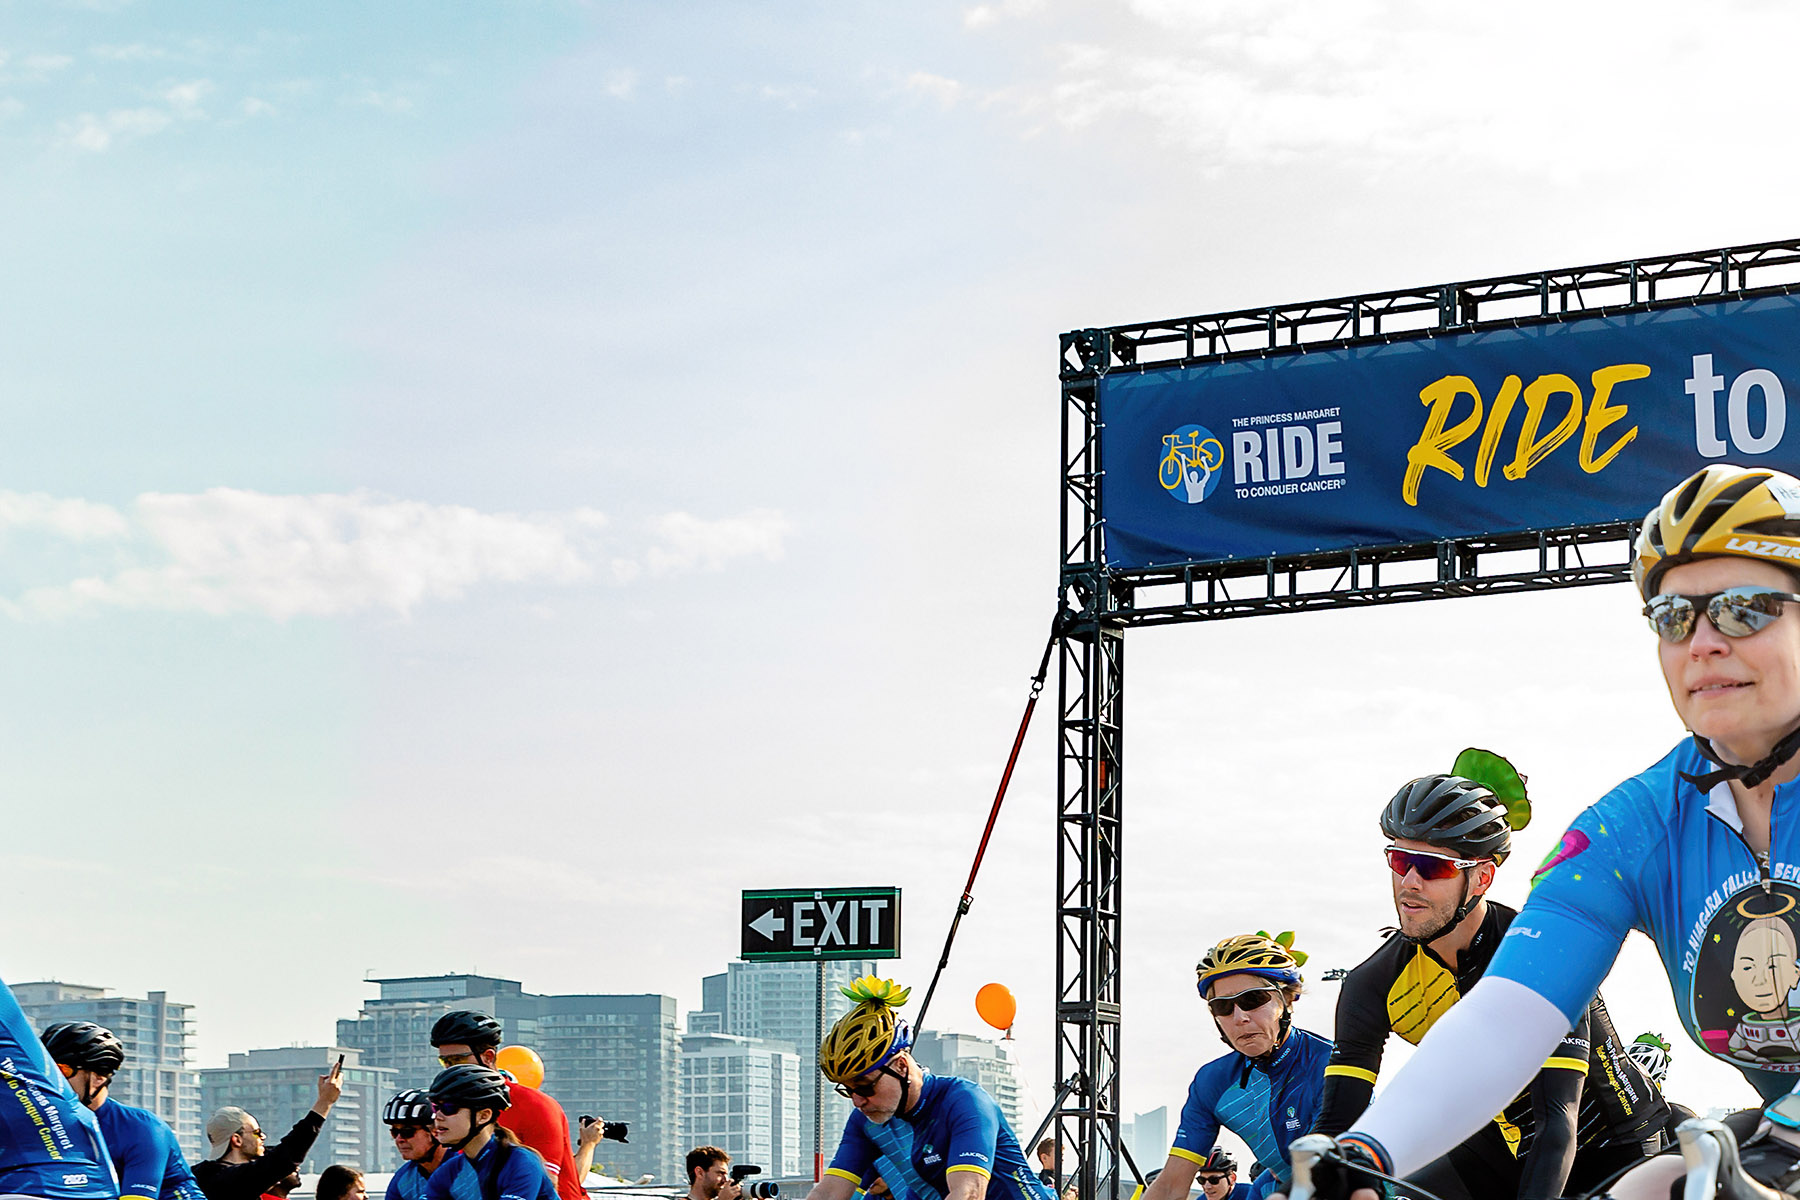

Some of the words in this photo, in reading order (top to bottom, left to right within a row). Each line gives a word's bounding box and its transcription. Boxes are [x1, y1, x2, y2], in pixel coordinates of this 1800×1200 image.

[1232, 418, 1249, 428] THE
[1250, 413, 1293, 425] PRINCESS
[1294, 407, 1341, 422] MARGARET
[1402, 363, 1652, 507] RIDE
[1684, 354, 1787, 458] to
[1232, 421, 1346, 485] RIDE
[1235, 488, 1249, 499] TO
[1250, 483, 1299, 498] CONQUER
[792, 900, 888, 946] EXIT
[1559, 1037, 1590, 1049] AKROO
[1616, 1069, 1640, 1104] Margaret
[1617, 1085, 1634, 1116] Cancer
[15, 1089, 45, 1132] Conquer
[38, 1126, 64, 1161] Cancer
[44, 1105, 74, 1150] Margaret
[923, 1154, 942, 1165] RIDE
[63, 1173, 88, 1186] 2023
